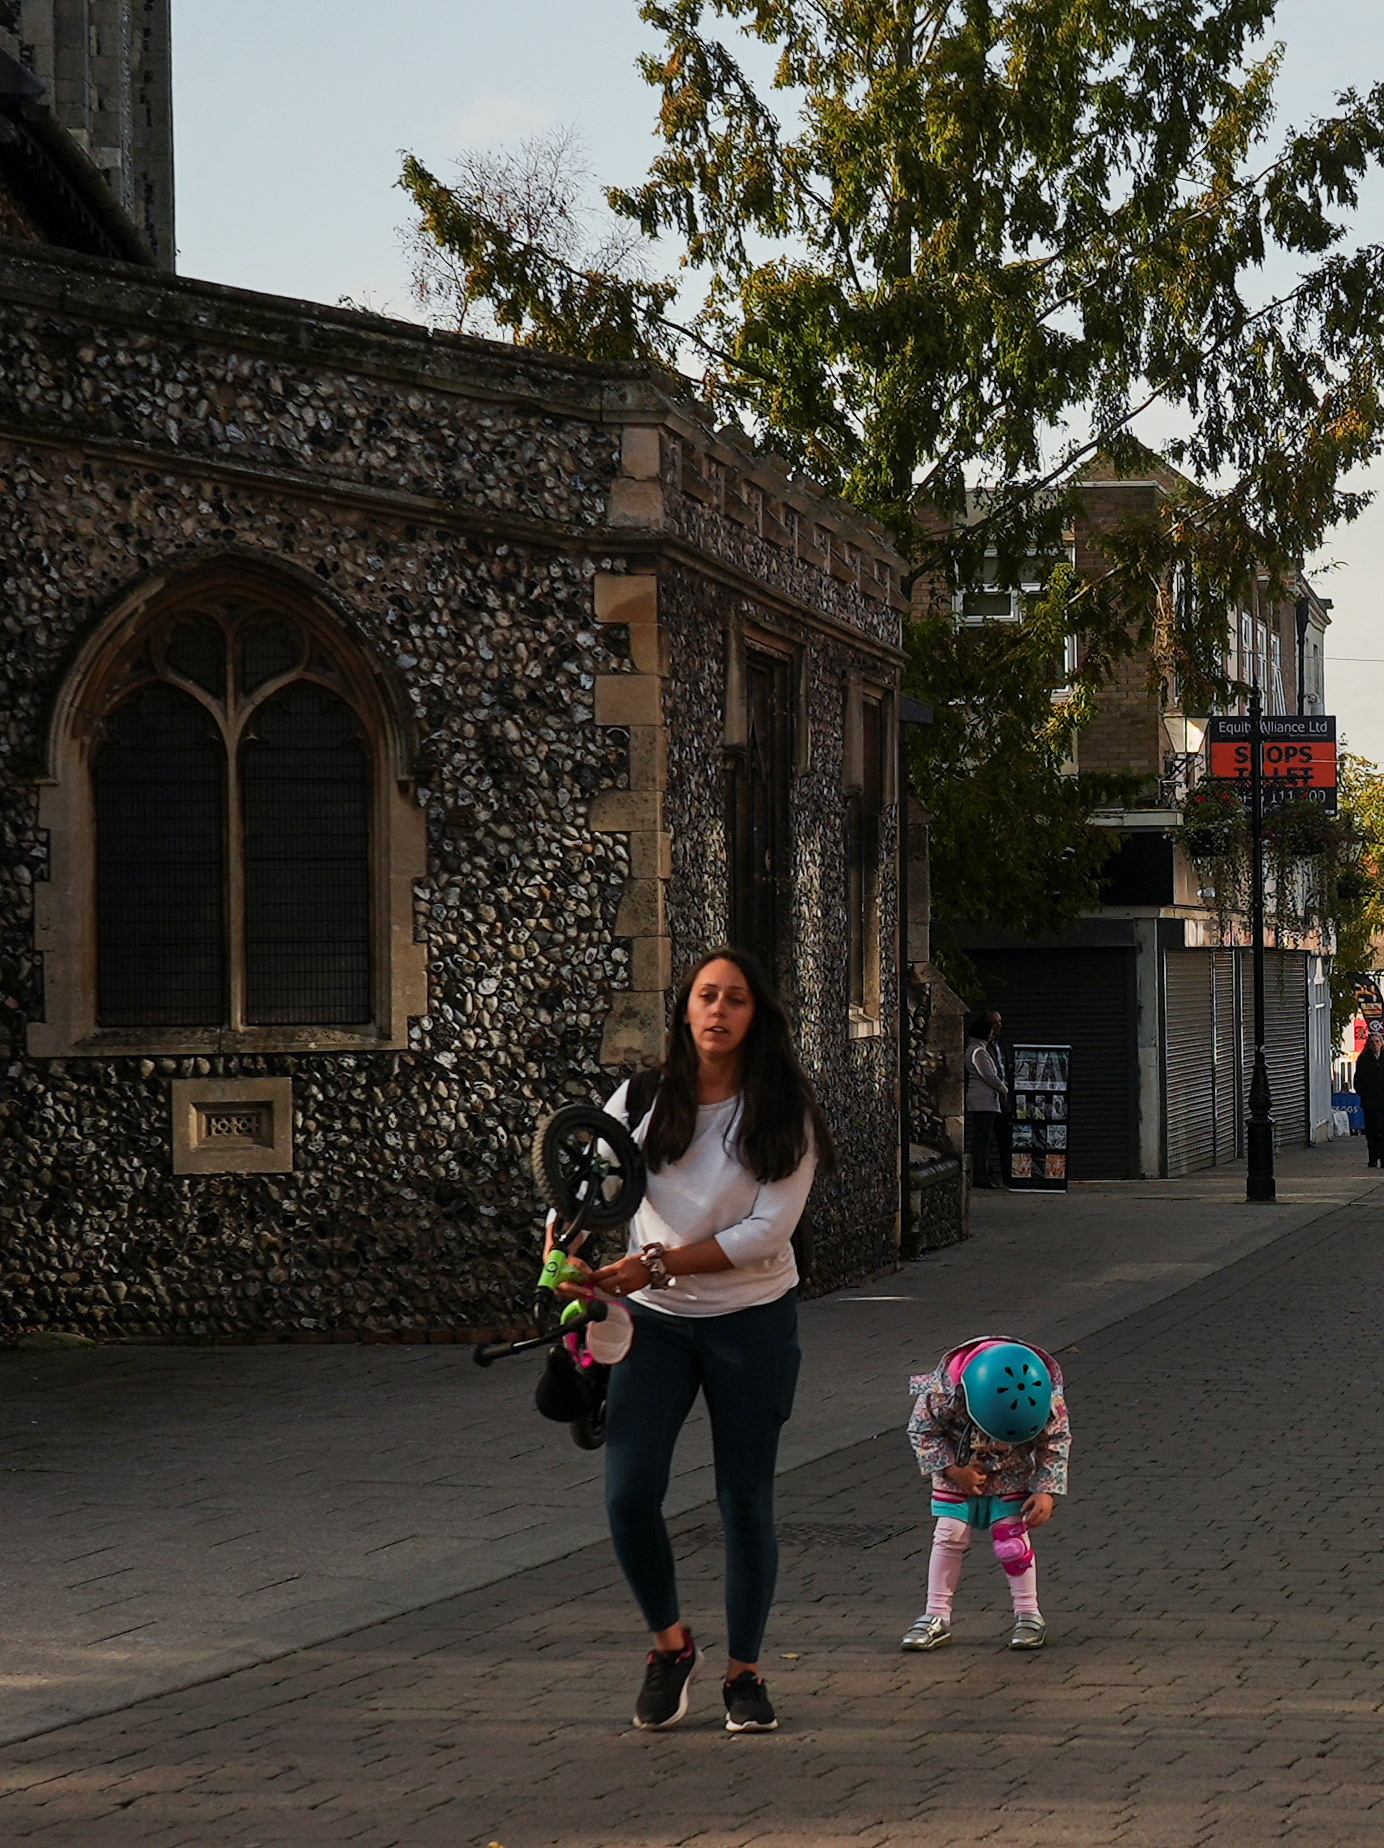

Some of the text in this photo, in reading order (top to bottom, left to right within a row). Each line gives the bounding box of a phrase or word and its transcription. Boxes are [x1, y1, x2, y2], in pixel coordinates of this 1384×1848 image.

[1260, 720, 1305, 733] Alliance
[1309, 720, 1328, 733] Ltd
[1234, 745, 1313, 764] SOPS
